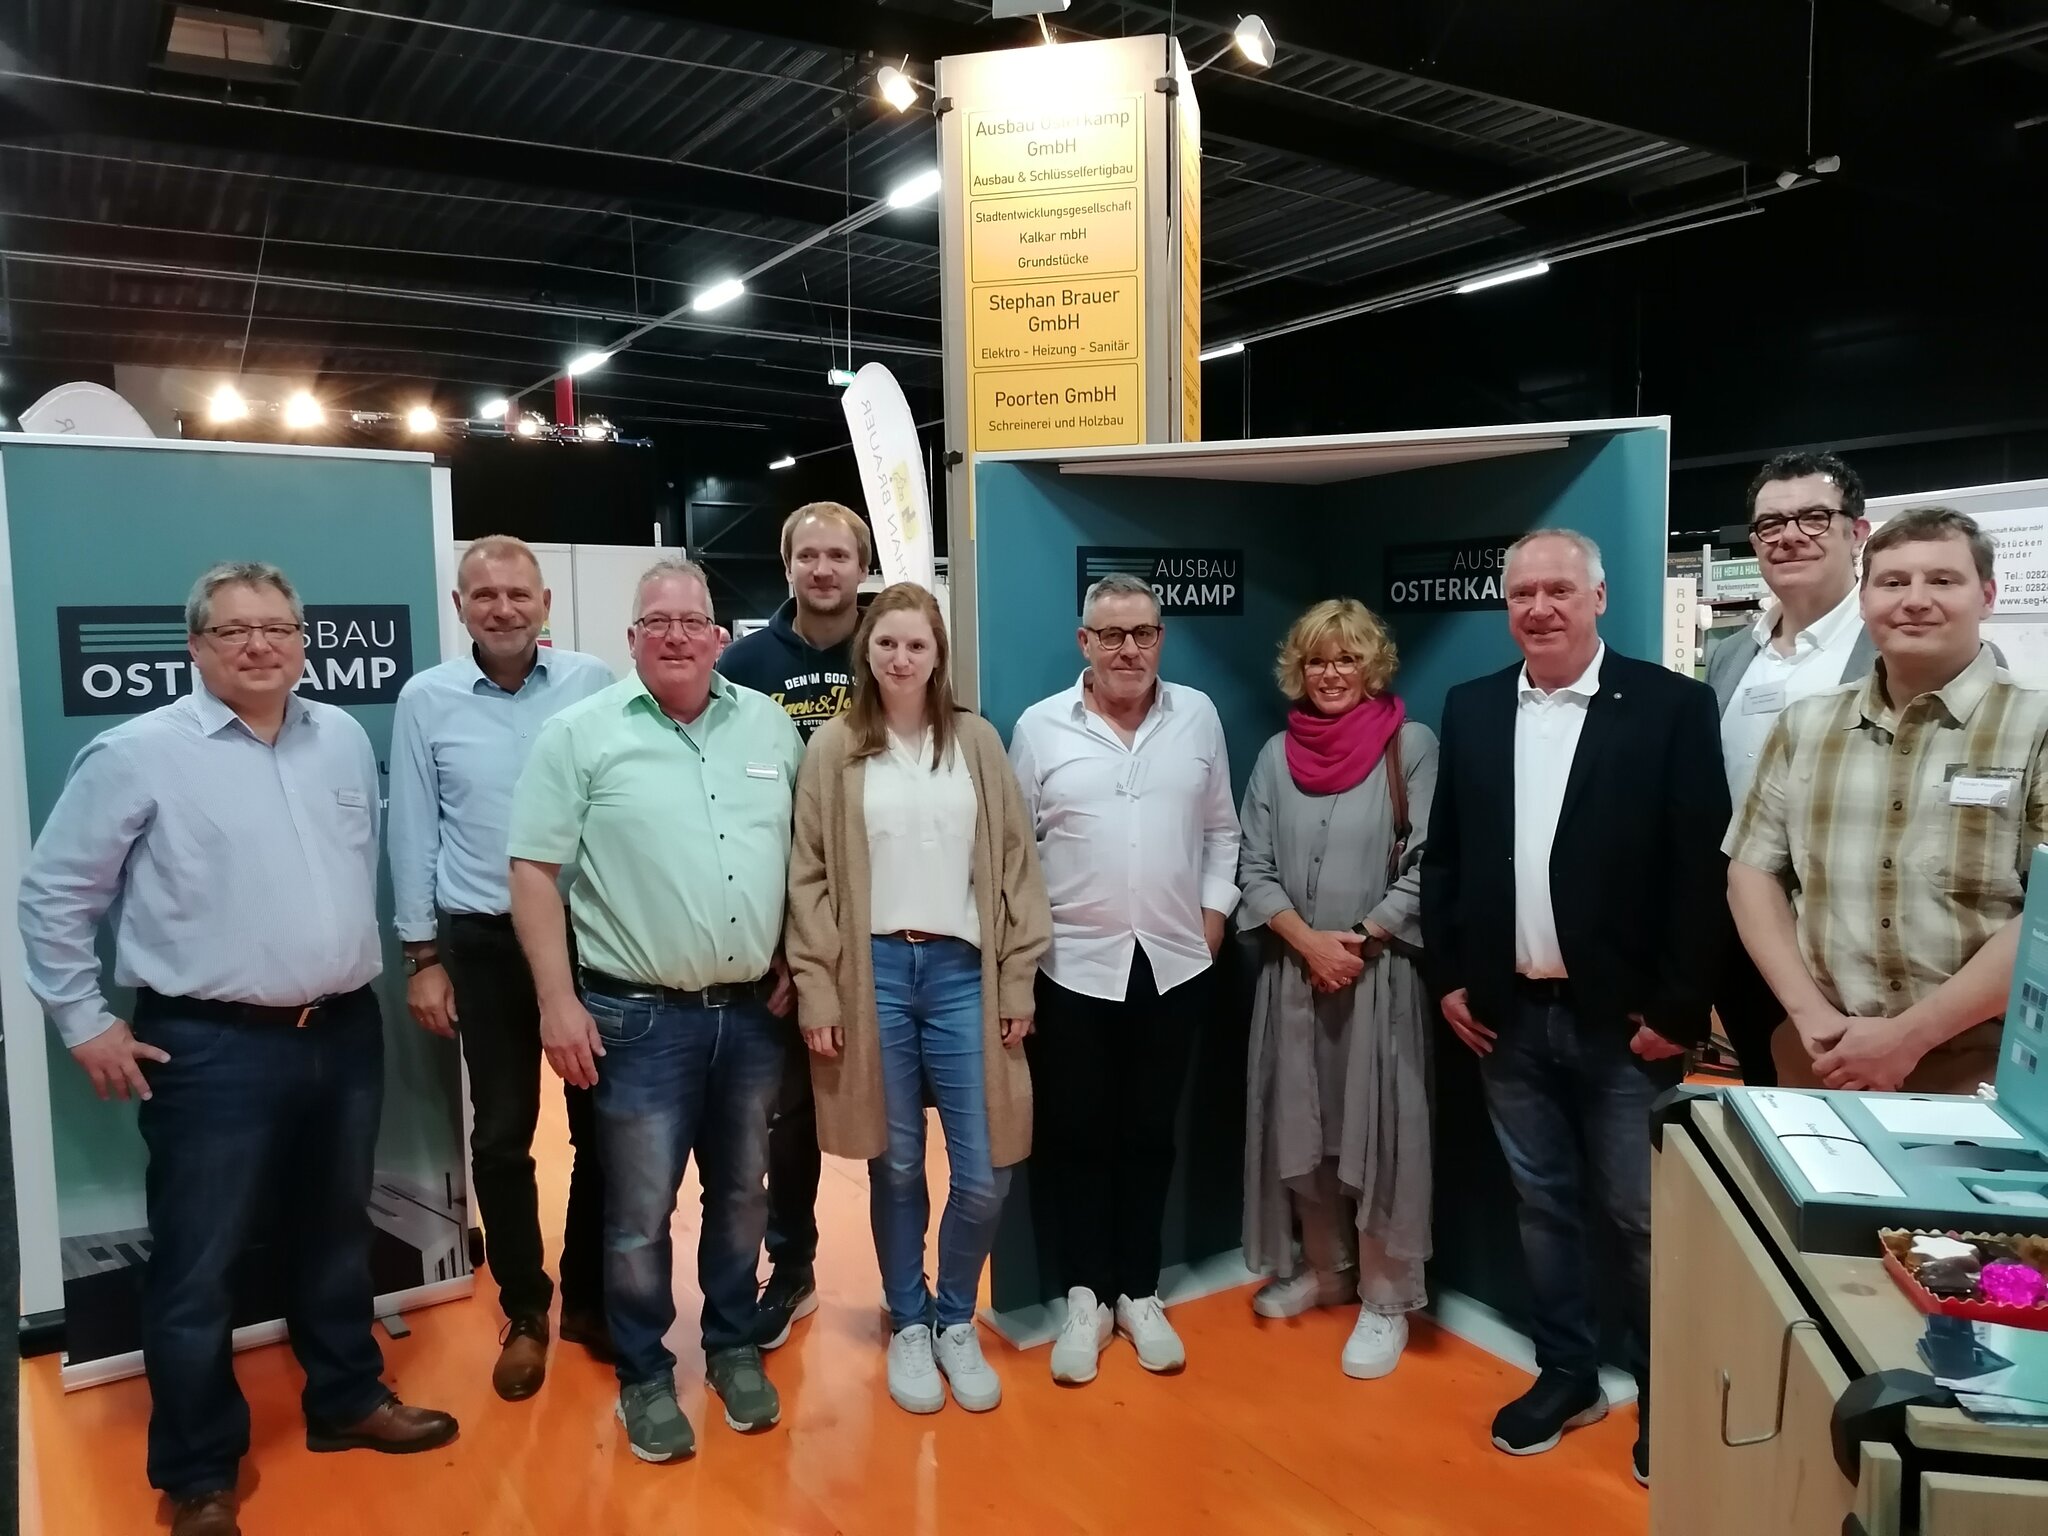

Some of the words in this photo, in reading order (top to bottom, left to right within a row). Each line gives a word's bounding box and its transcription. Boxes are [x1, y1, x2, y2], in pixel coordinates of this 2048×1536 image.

[975, 119, 1035, 137] Ausbau
[1027, 137, 1077, 157] GmbH
[973, 173, 1015, 187] Ausbau
[1017, 171, 1027, 183] &
[1029, 163, 1134, 182] Schlüsselfertigbau
[975, 200, 1132, 223] Stadtentwicklungsgesellschaft
[1019, 231, 1056, 244] Kalkar
[1060, 228, 1087, 241] mbH
[1018, 252, 1089, 269] Grundstücke
[989, 292, 1056, 313] Stephan
[1062, 289, 1120, 306] Brauer
[1028, 313, 1080, 333] GmbH
[981, 347, 1020, 360] Elektro
[1032, 343, 1077, 357] Heizung
[1089, 339, 1130, 353] Sanitär
[995, 390, 1059, 408] Poorten
[1065, 384, 1117, 404] GmbH
[988, 417, 1051, 432] Schreinerei
[1054, 416, 1075, 429] und
[1079, 415, 1124, 428] Holzbau
[1994, 539, 2043, 549] dstücken
[1454, 547, 1508, 572] AUSB
[1996, 551, 2032, 560] ründer
[1155, 558, 1236, 578] AUSBAU
[1745, 563, 1761, 575] HAU
[2025, 570, 2048, 580] 0282
[1151, 583, 1236, 606] RKAMP
[1390, 575, 1506, 603] OSTERKA
[2004, 584, 2023, 593] Fax:
[2025, 583, 2048, 592] 0282
[1999, 595, 2048, 607] www.seg-k
[1674, 588, 1686, 673] ROLLOM
